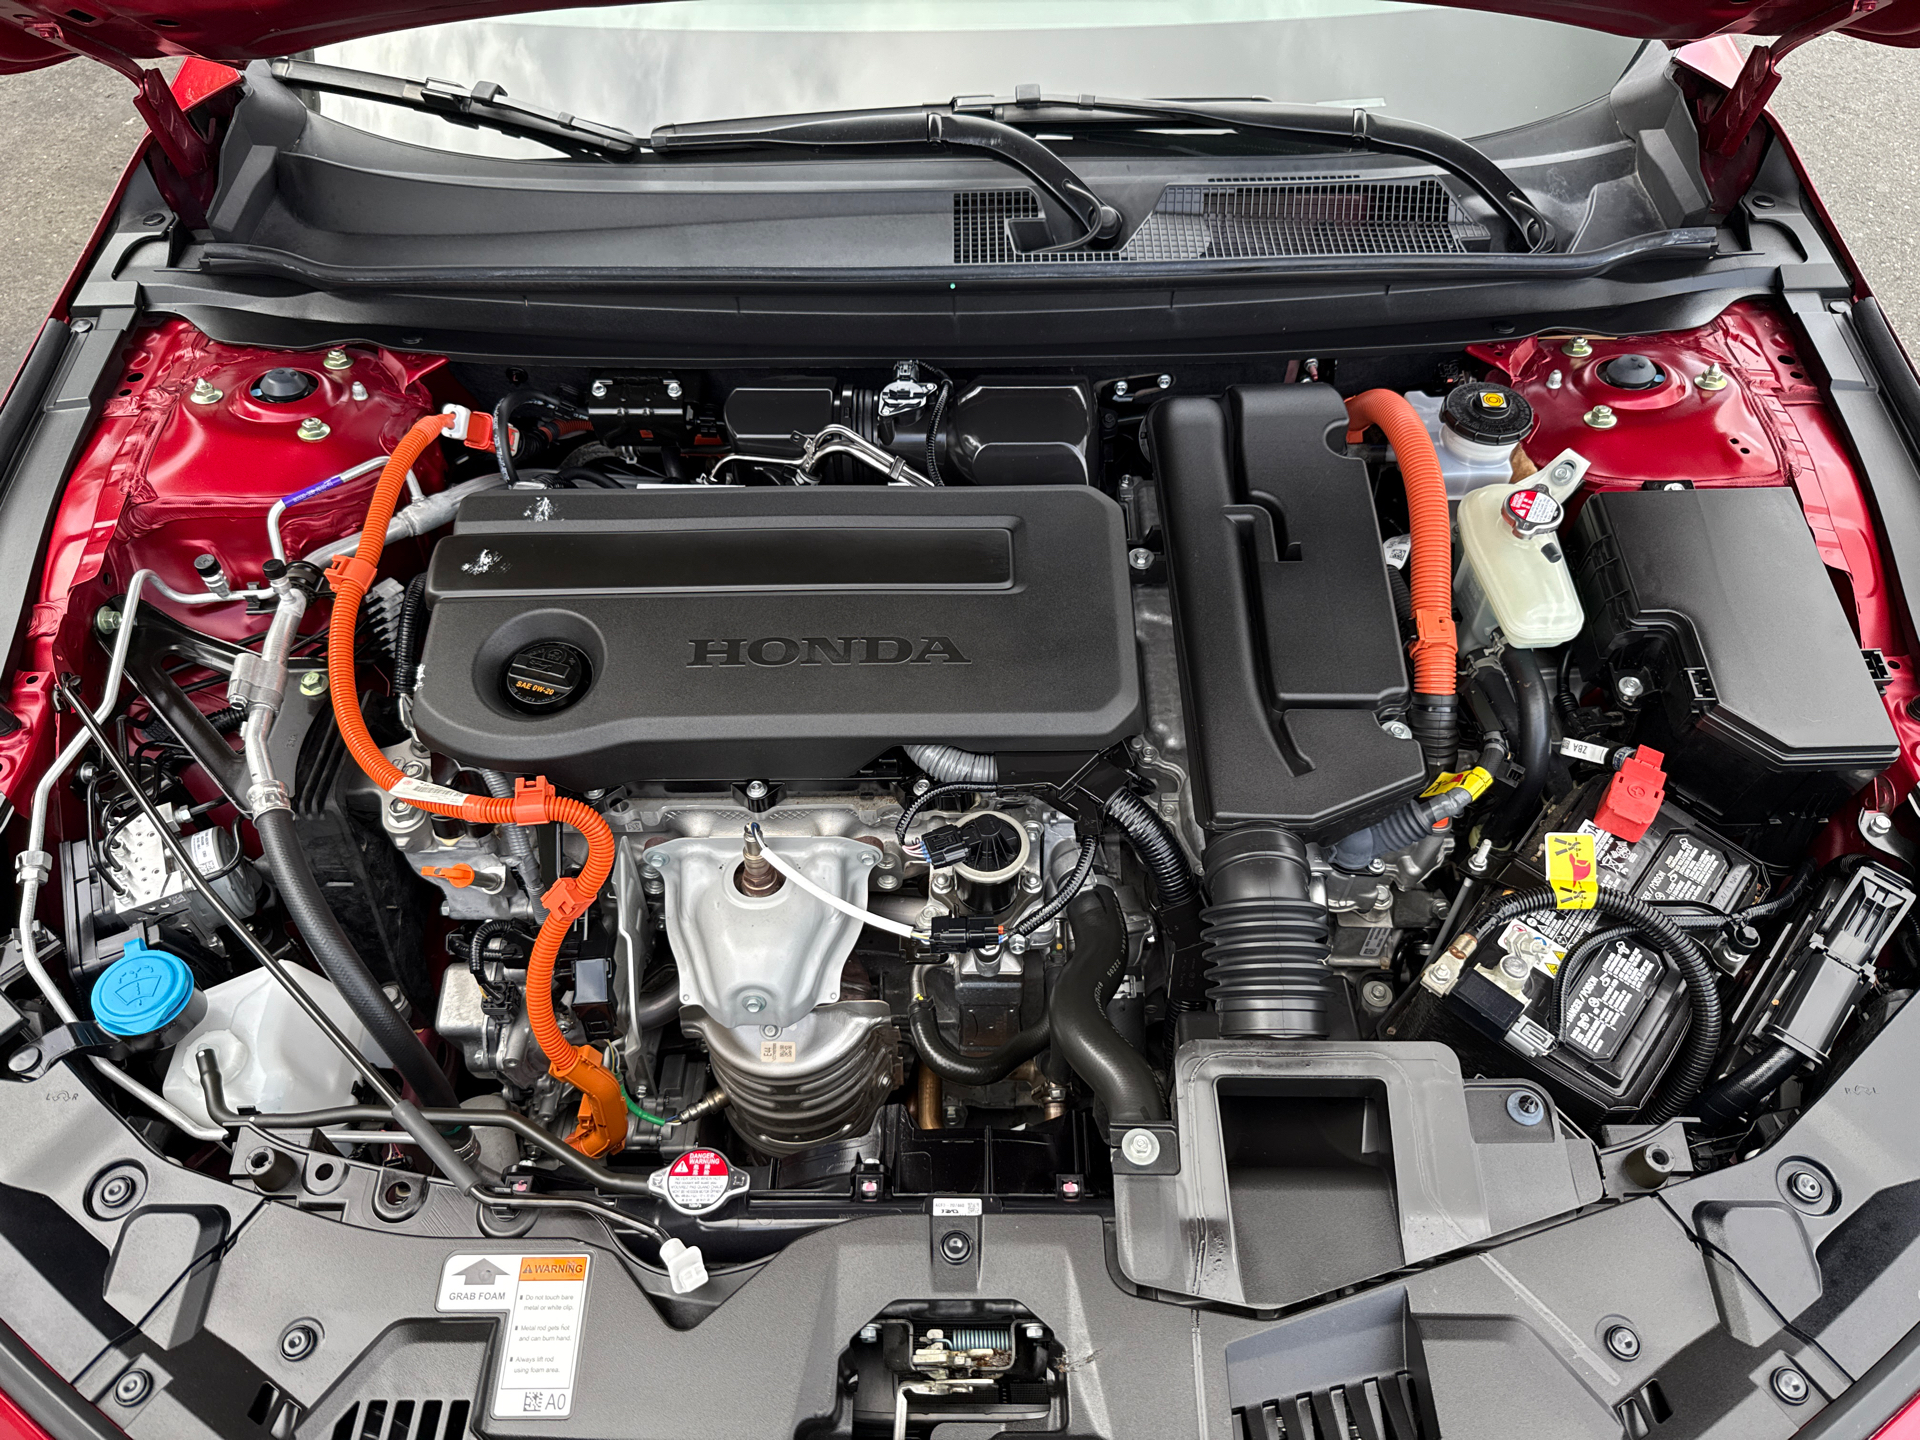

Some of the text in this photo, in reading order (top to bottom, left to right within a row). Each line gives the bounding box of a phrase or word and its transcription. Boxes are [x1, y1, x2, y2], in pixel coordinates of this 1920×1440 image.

[686, 636, 972, 667] HONDA
[515, 680, 532, 690] SAE
[532, 684, 555, 695] 0W-20
[534, 1264, 583, 1274] WARNING
[449, 1292, 506, 1300] GRAB FOAM
